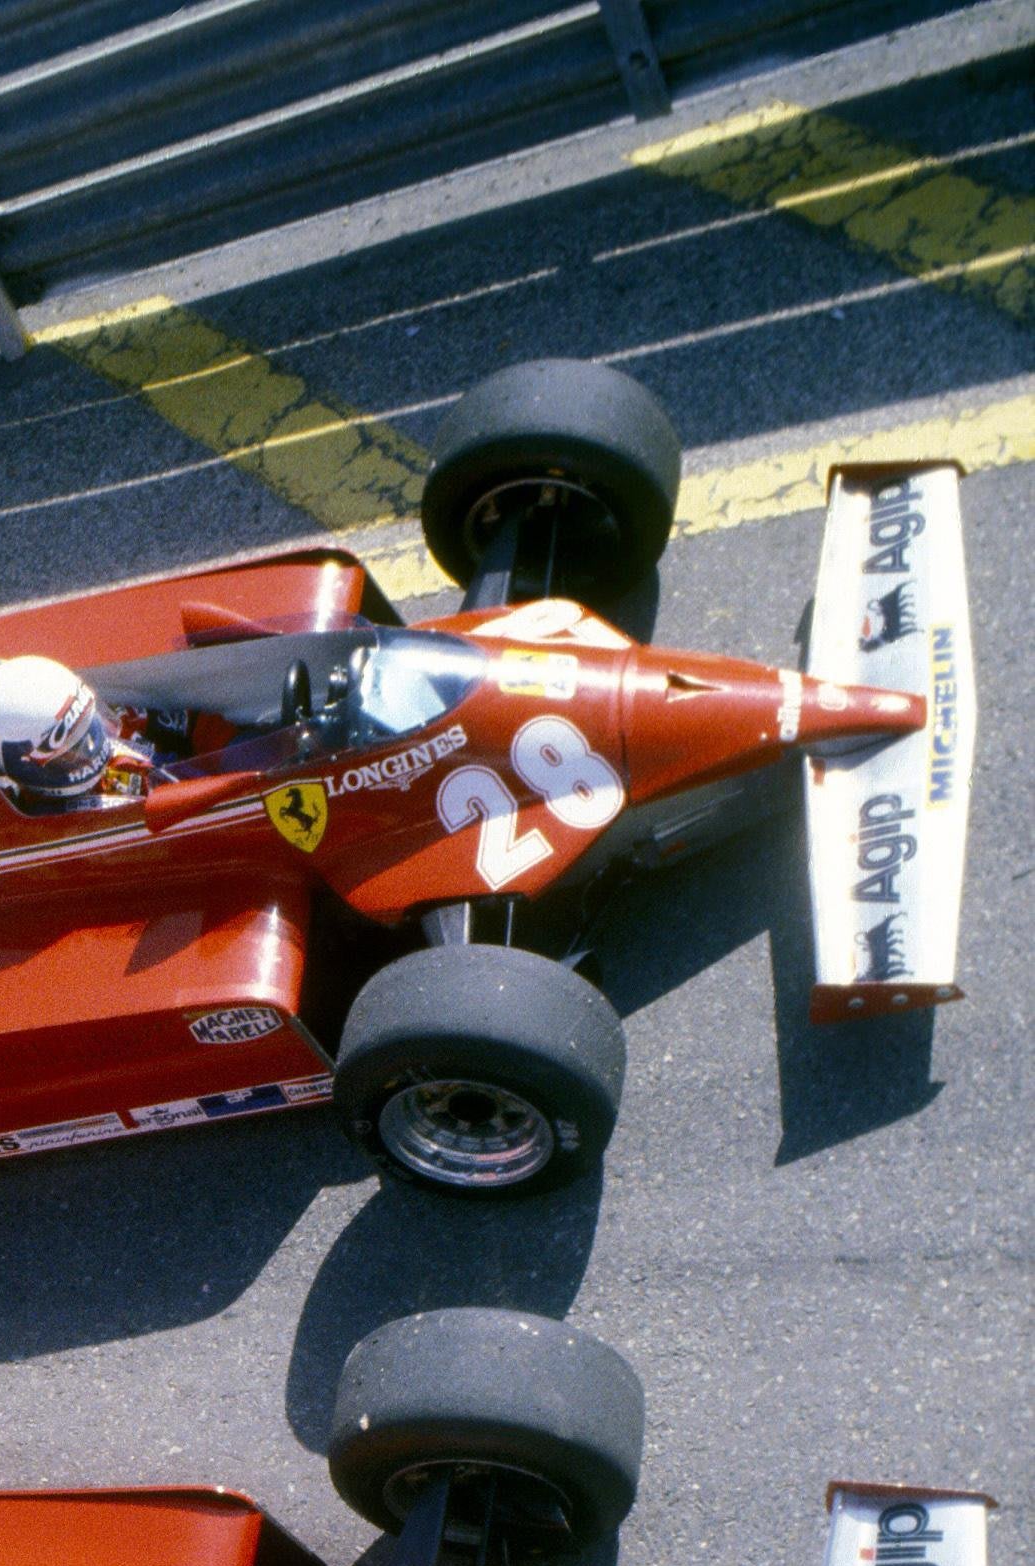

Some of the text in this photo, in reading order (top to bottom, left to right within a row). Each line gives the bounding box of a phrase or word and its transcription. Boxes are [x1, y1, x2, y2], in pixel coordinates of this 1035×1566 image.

[861, 476, 927, 575] Agip
[324, 723, 468, 798] LONGINES
[929, 627, 958, 804] MICHELIN
[436, 713, 626, 892] 28
[851, 793, 918, 904] Agip
